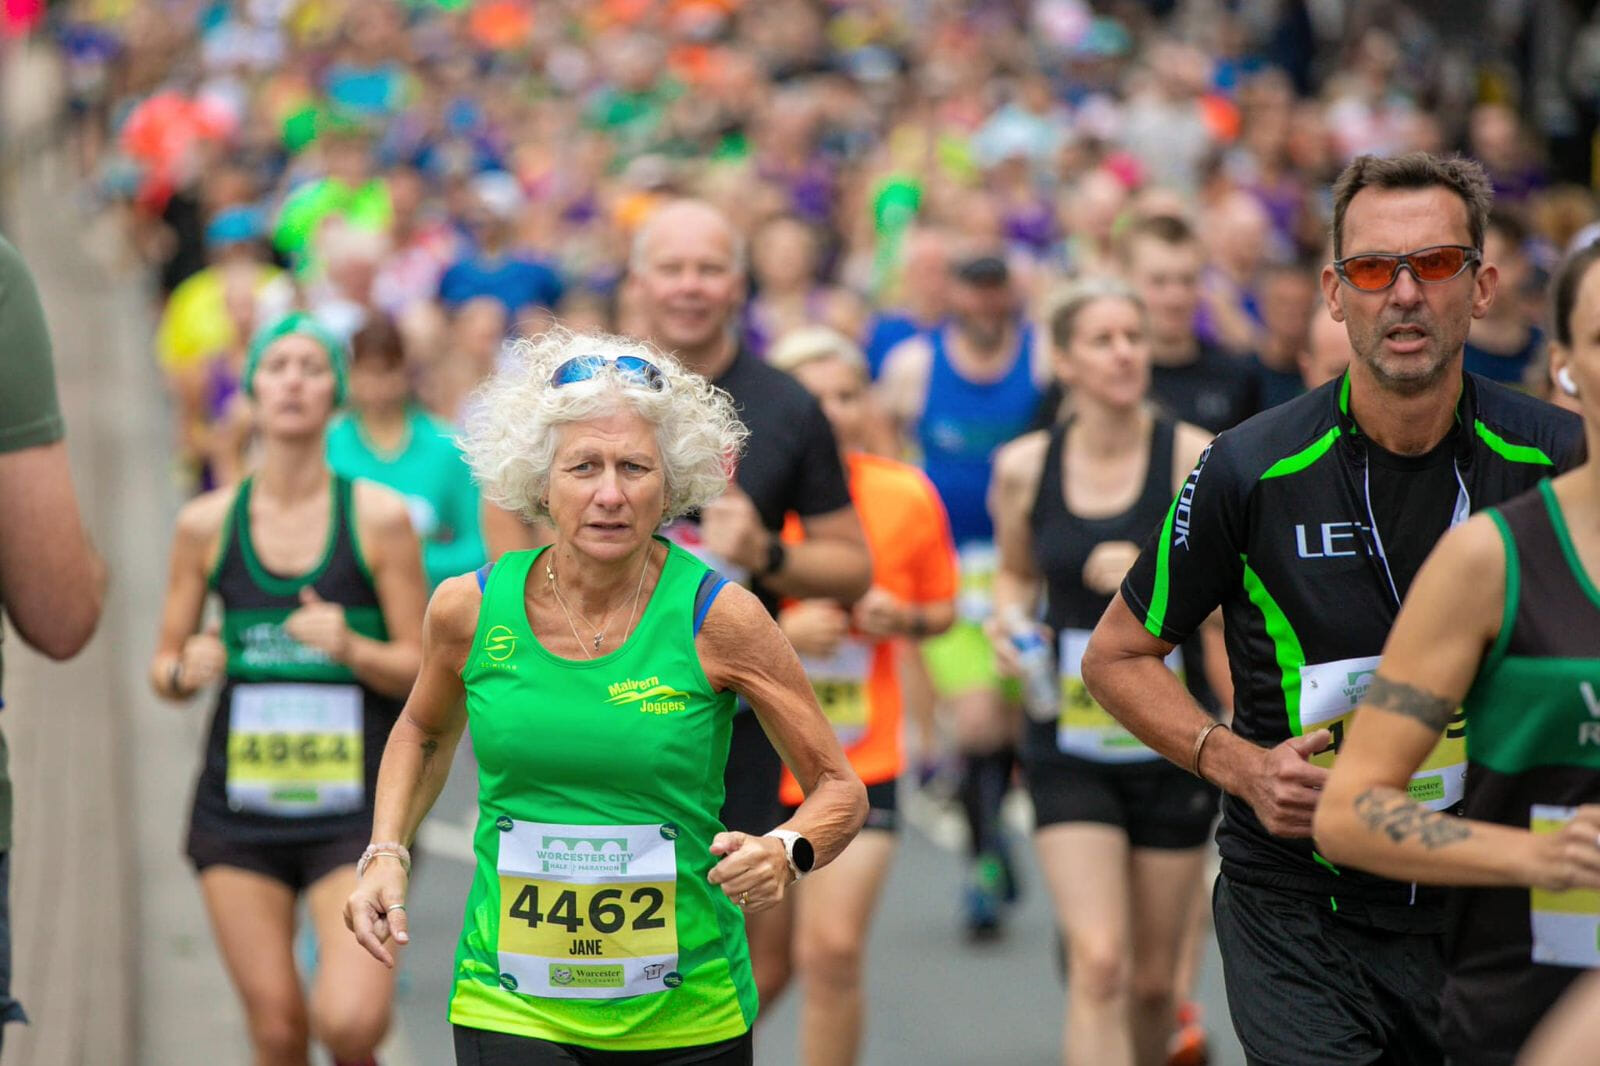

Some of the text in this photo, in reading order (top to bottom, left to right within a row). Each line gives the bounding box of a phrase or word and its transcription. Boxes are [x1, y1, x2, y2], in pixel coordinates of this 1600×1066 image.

[608, 676, 659, 697] Malvern
[640, 700, 686, 715] Joggers
[536, 850, 634, 862] WORCESTER CITY
[578, 864, 619, 872] MARATHON
[509, 884, 665, 934] 4462
[569, 939, 603, 956] JANE
[576, 969, 621, 977] Worcester
